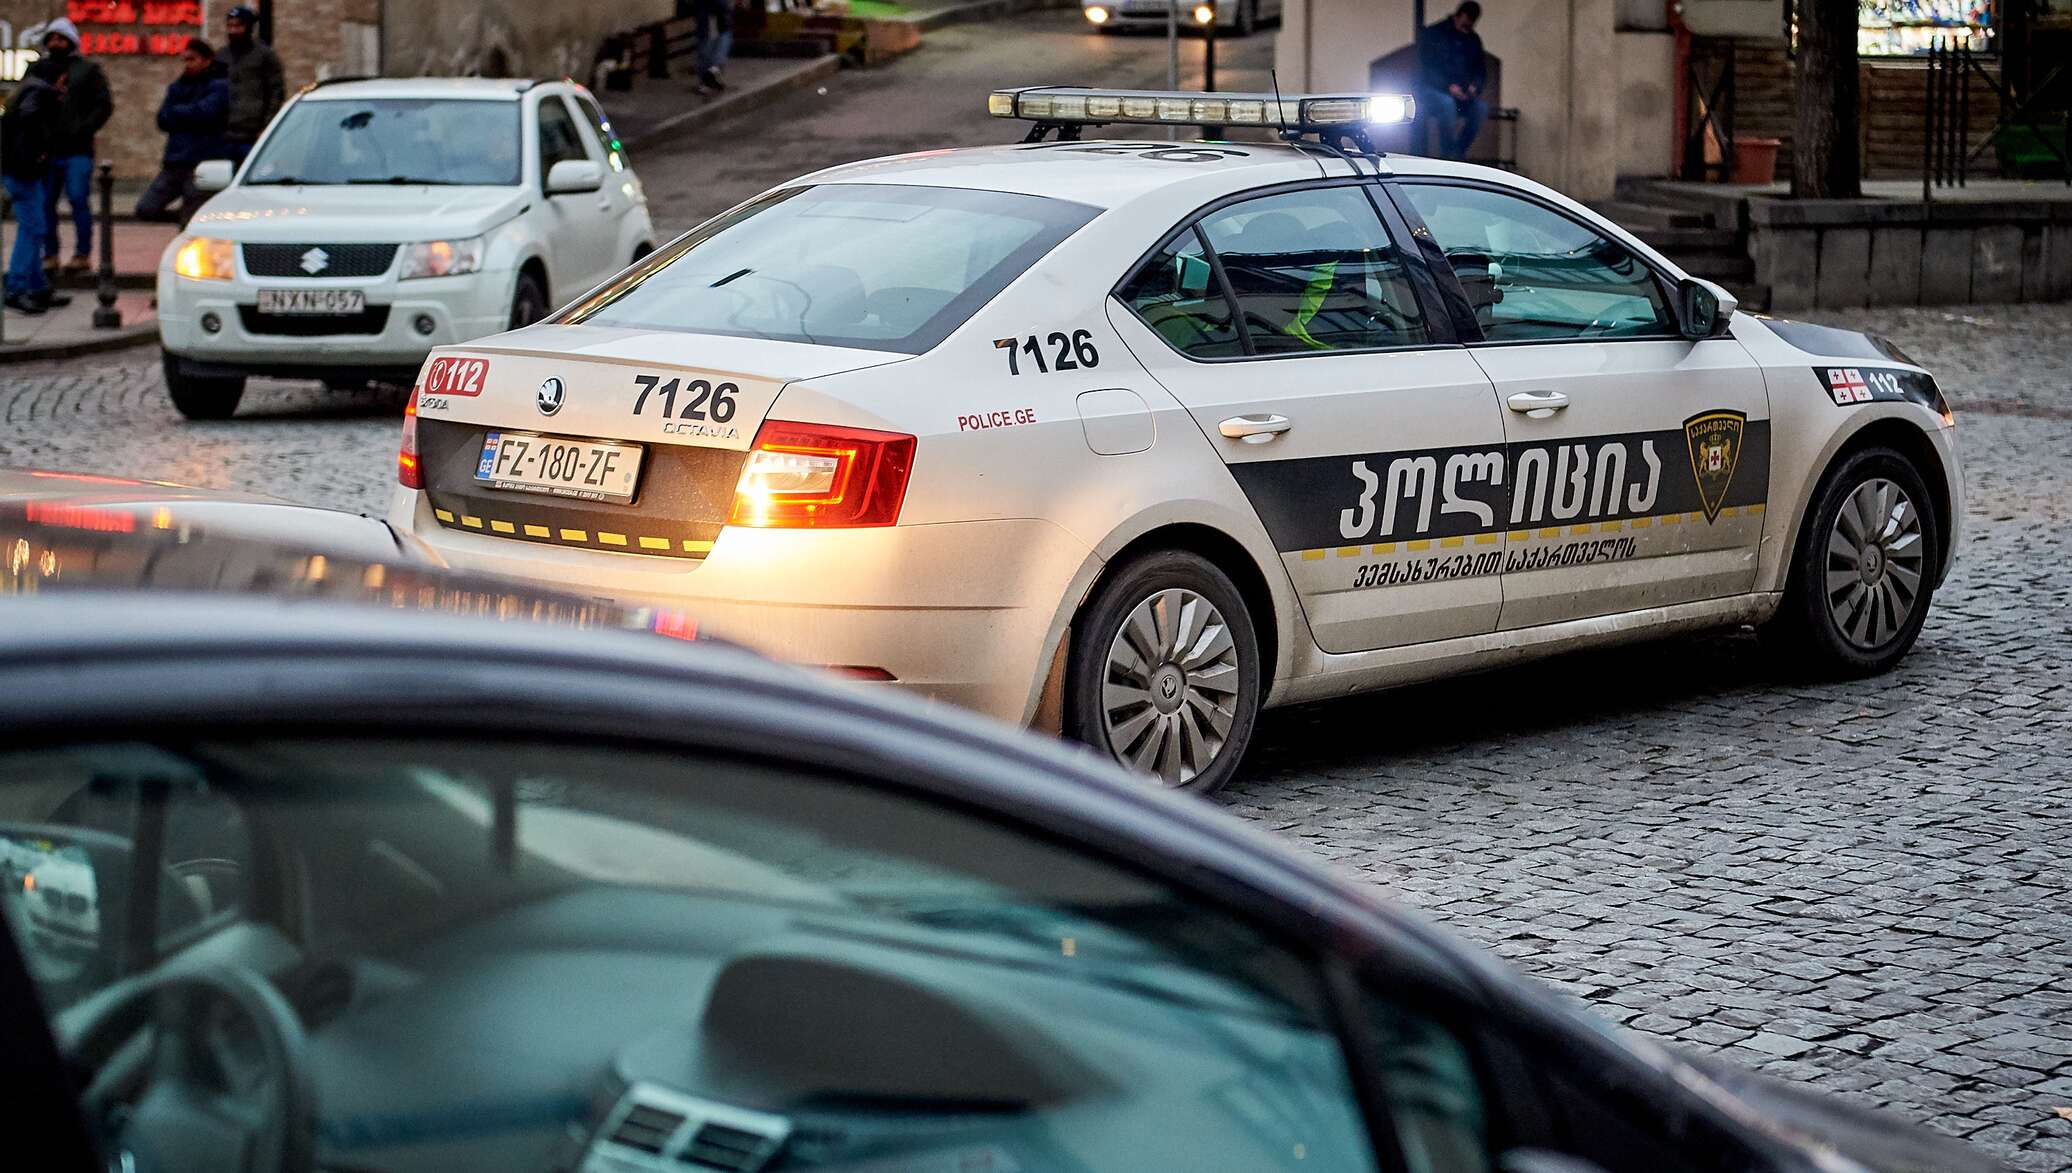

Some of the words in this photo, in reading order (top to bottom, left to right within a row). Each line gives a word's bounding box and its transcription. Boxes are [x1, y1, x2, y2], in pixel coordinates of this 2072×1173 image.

[271, 290, 362, 309] NXN-057
[993, 329, 1099, 376] 7126
[446, 360, 484, 393] 112
[1869, 372, 1905, 394] 112
[633, 375, 740, 424] 7126
[664, 422, 740, 440] OCTAVIA
[958, 408, 1037, 432] POLICE.GE
[479, 458, 493, 474] GE
[495, 439, 621, 486] FZ-180-ZF
[1340, 440, 1662, 539] პოლიცია
[1353, 551, 1503, 588] ვემსახურებით
[1505, 536, 1637, 572] საქართველოს
